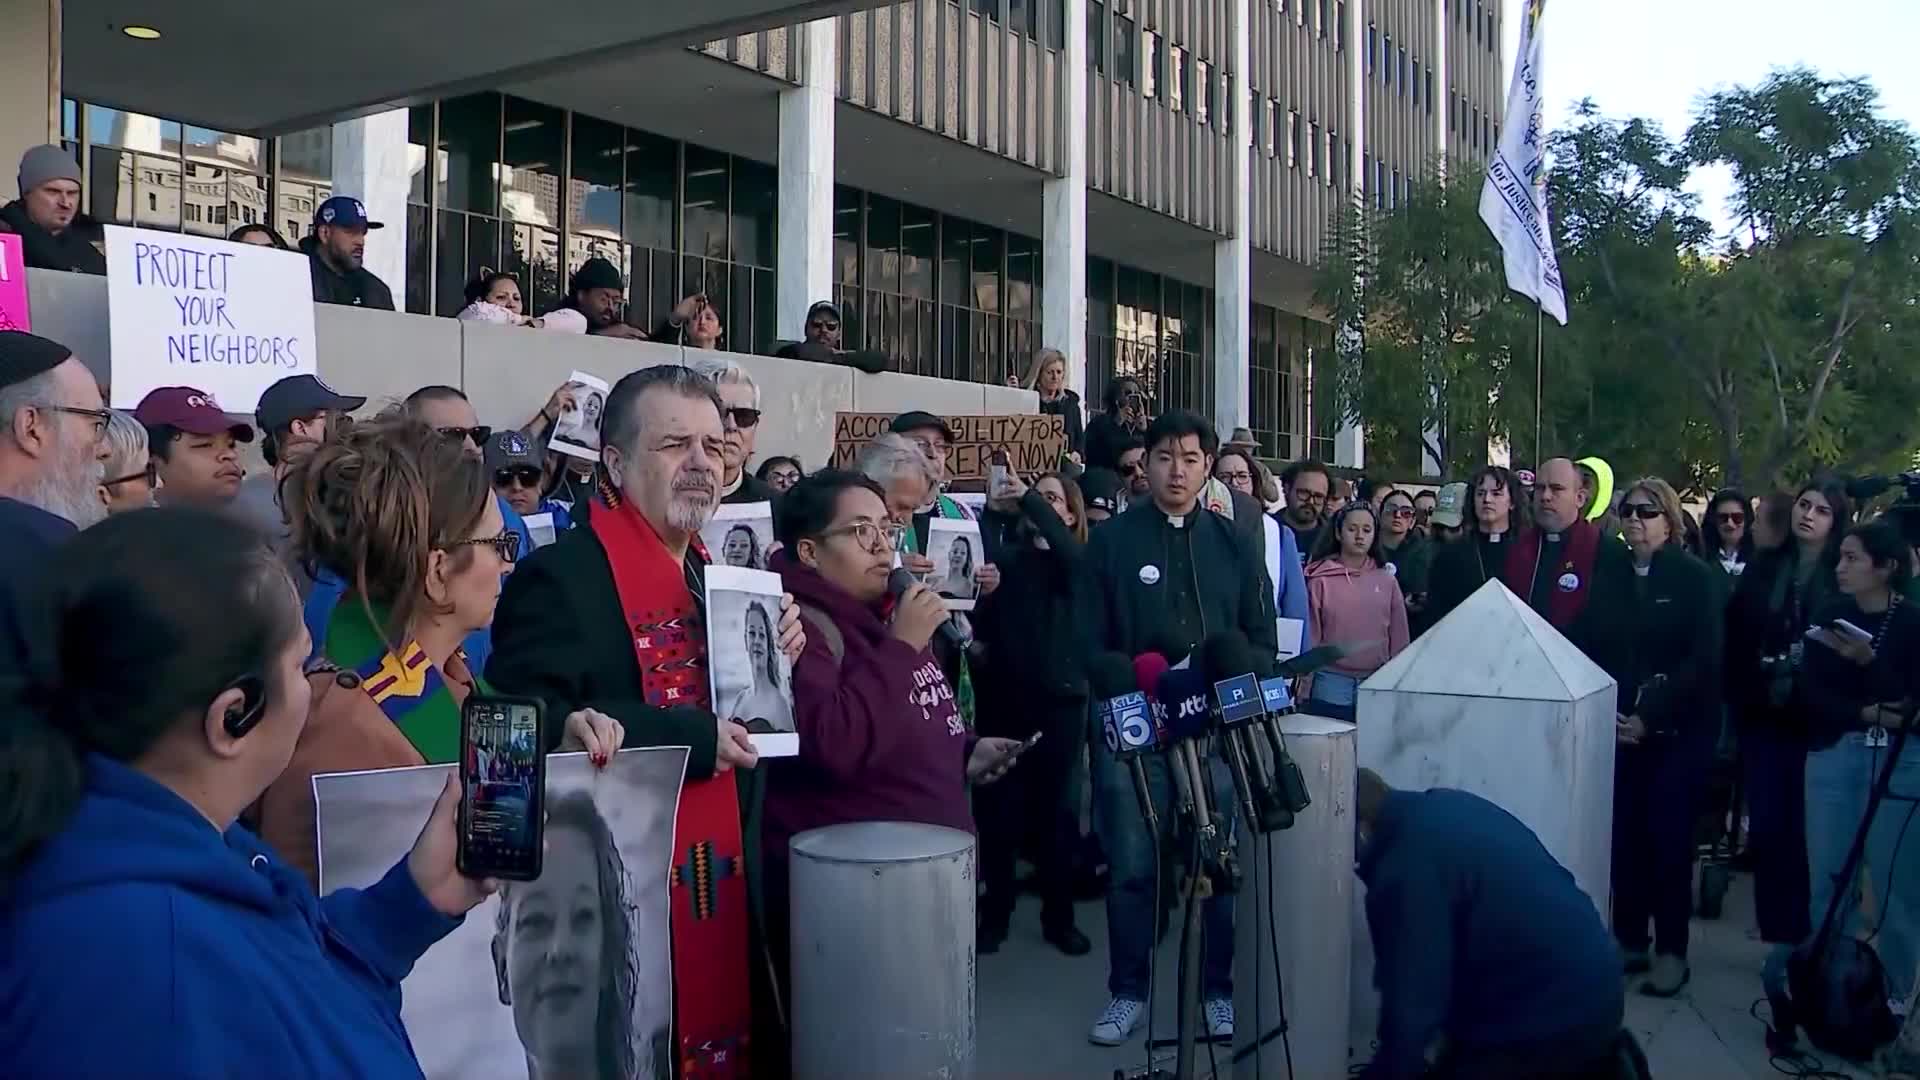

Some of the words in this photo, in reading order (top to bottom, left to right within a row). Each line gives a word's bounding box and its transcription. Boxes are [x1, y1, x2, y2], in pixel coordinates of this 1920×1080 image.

[1489, 161, 1509, 182] for
[1500, 181, 1535, 222] Justice
[135, 242, 236, 294] PROTECT
[173, 294, 236, 330] YOUR
[168, 333, 299, 369] NEIGHBORS
[836, 416, 1025, 441] ACCOBILITY
[1028, 416, 1064, 441] FOR
[1110, 694, 1145, 709] KTLA
[1122, 706, 1151, 746] 5
